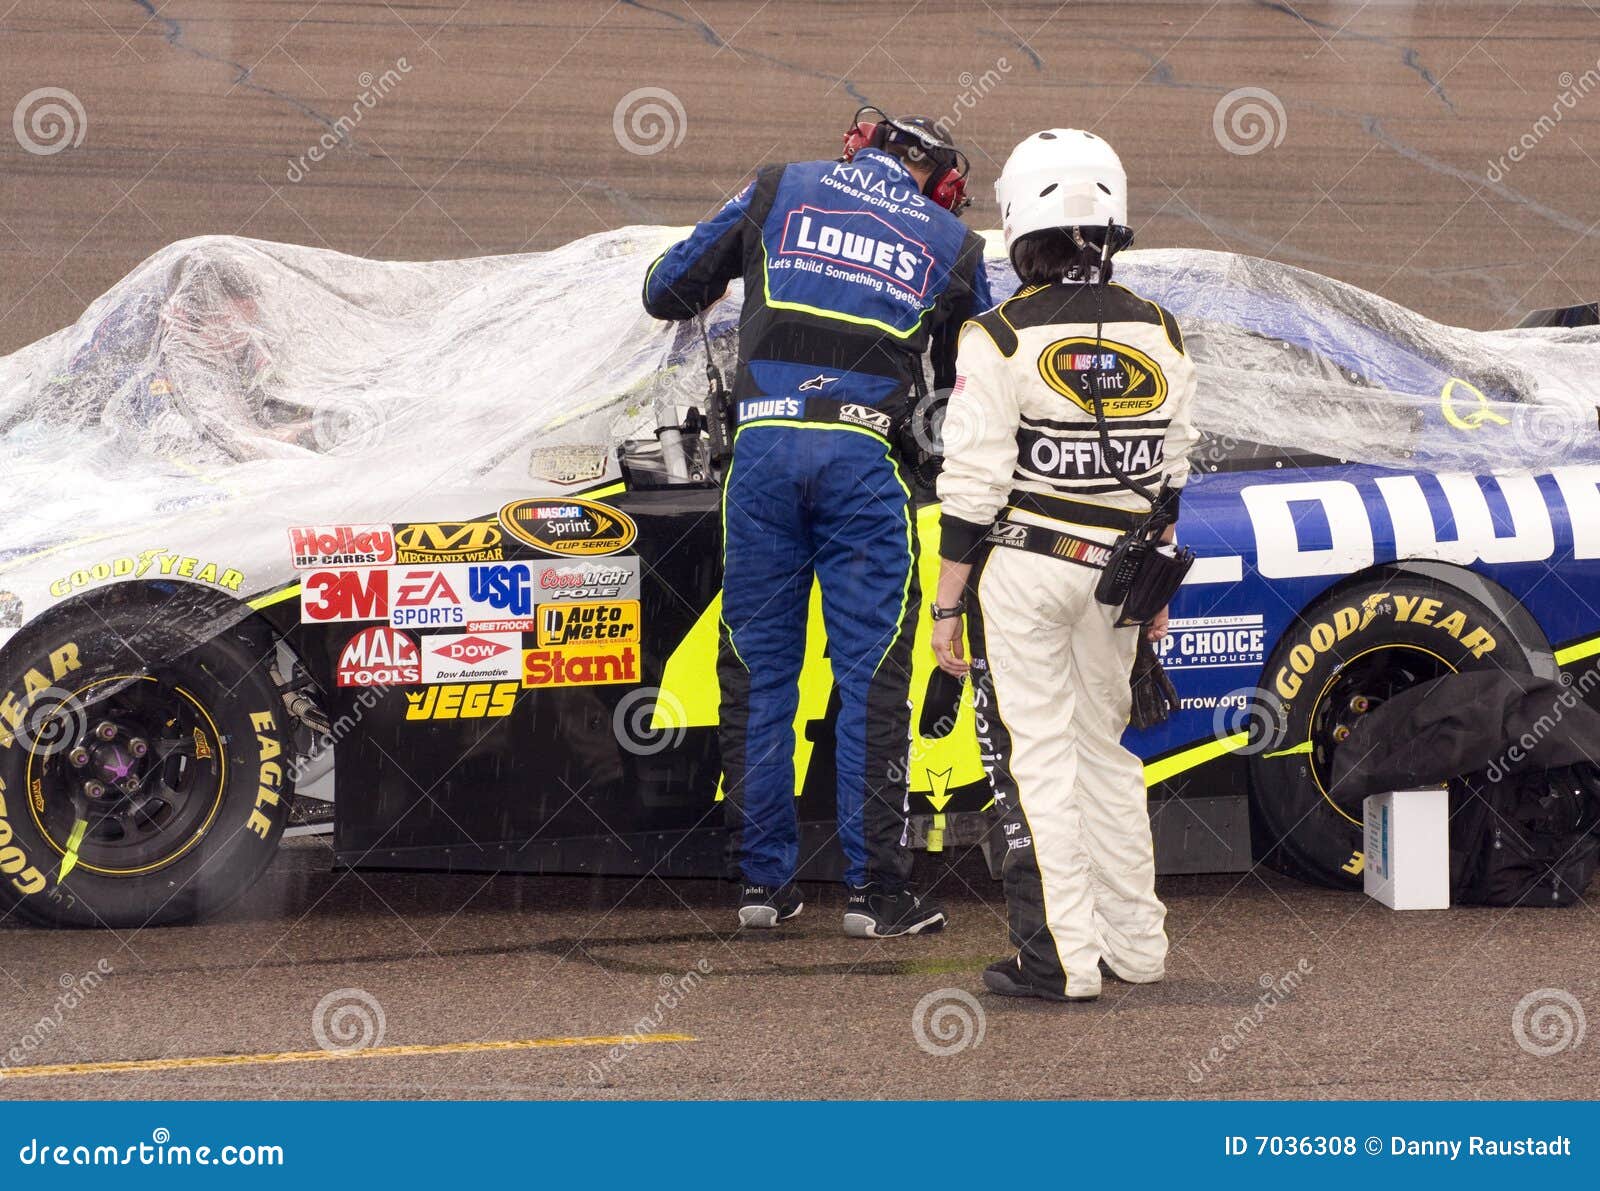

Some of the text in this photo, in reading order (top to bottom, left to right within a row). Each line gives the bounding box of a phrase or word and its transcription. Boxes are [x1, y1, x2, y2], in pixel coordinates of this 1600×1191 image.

[832, 164, 926, 207] KNAUS
[820, 174, 931, 223] lowesracing.com
[796, 216, 918, 281] LOWE'S
[768, 258, 791, 269] Let's
[794, 258, 822, 274] Build
[825, 265, 883, 291] Something
[1080, 372, 1124, 394] Srint
[739, 397, 799, 422] LOWE'S
[1112, 399, 1153, 409] SERIES
[537, 506, 580, 519] NASCAR
[547, 520, 592, 536] Sprint
[291, 527, 393, 562] Holley
[581, 540, 621, 548] SERIES
[296, 554, 376, 565] HP CARBS
[397, 547, 504, 564] MECHANIX WEAR
[1082, 545, 1113, 567] NAS
[395, 571, 461, 607] EA
[540, 567, 634, 589] Coors LIGHT
[305, 569, 389, 620] 3M
[468, 564, 532, 616] USG
[552, 587, 621, 600] POLE
[393, 607, 464, 625] SPORTS
[468, 620, 531, 632] SHEETROCK
[566, 606, 623, 624] Auto
[1203, 617, 1245, 625] QUALITY
[563, 623, 635, 645] Meter
[1180, 630, 1264, 656] CHOICE
[340, 629, 419, 669] MAC
[450, 645, 497, 658] DOW
[1191, 653, 1263, 664] PRODUCTS
[340, 669, 419, 684] TOOLS
[436, 669, 508, 679] Dow Automotive
[526, 647, 636, 686] Stant
[406, 682, 520, 721] JEGS
[246, 710, 283, 841] EAGLE
